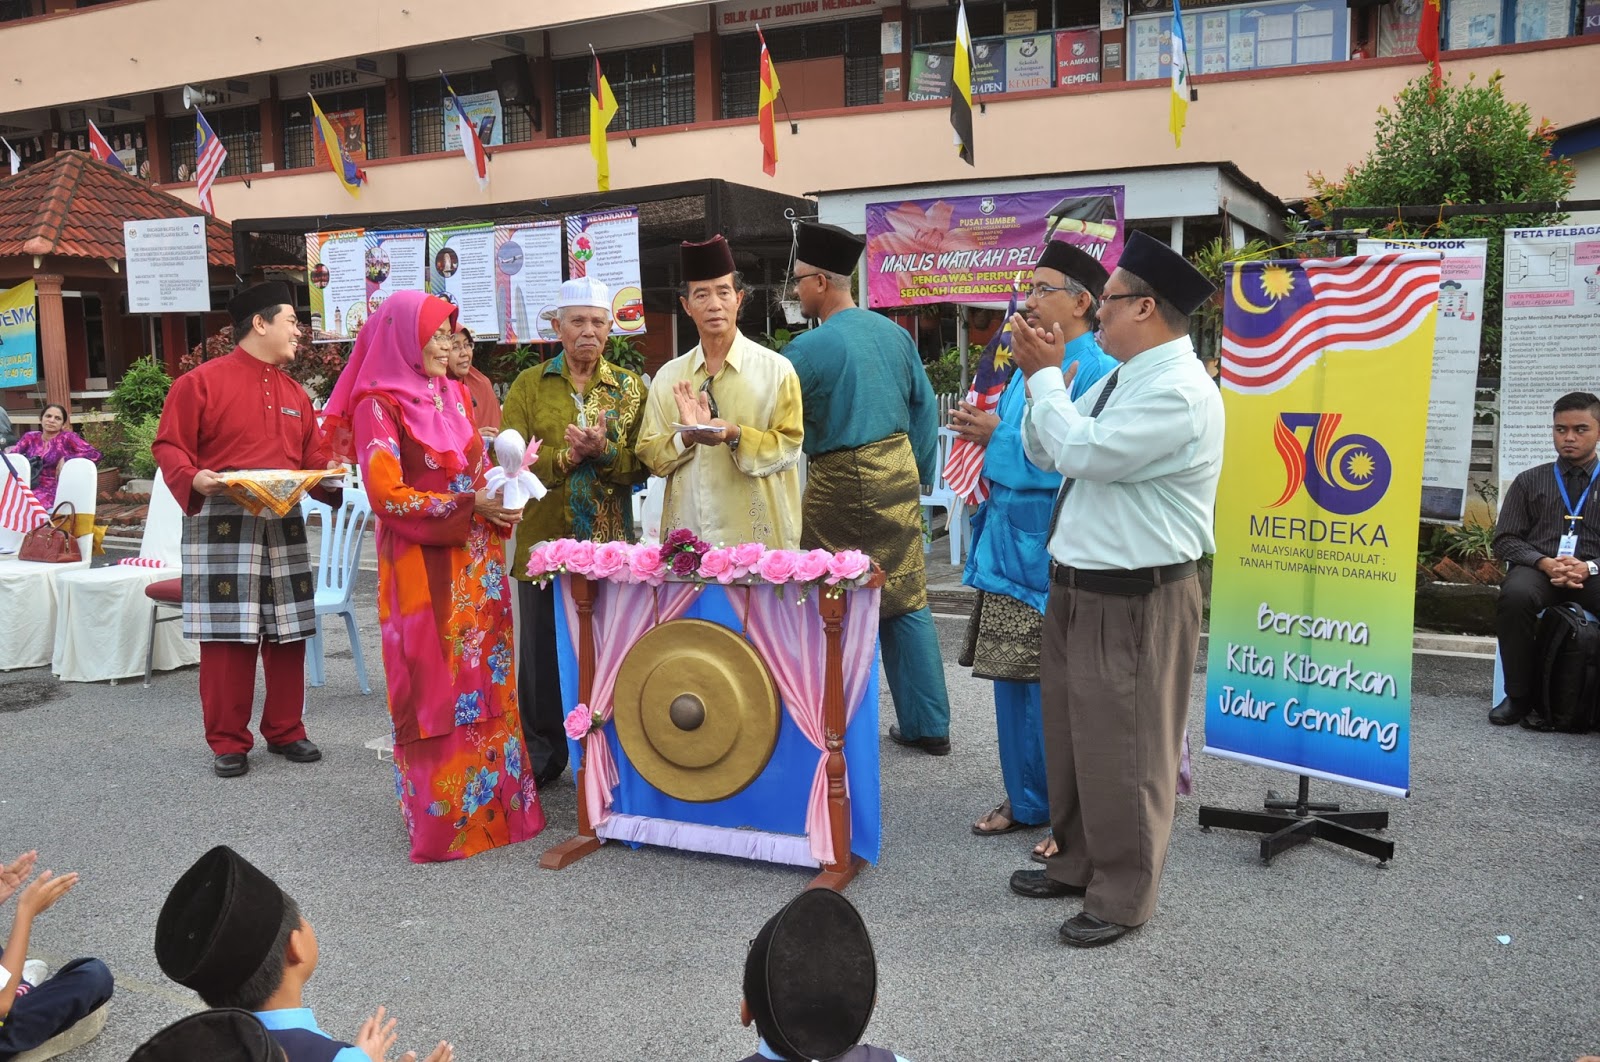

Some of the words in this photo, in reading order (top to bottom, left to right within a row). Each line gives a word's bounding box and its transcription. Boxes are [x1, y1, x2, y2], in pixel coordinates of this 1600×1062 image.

[724, 11, 747, 25] BILIK
[750, 7, 772, 21] ALAT
[776, 0, 818, 18] BANTUAN
[1070, 56, 1100, 66] AMPANG
[1008, 77, 1049, 89] KEMPEN
[1062, 72, 1099, 85] KEMPEN
[970, 82, 1003, 94] EMPEN
[586, 210, 632, 222] NEGARAKU
[960, 218, 984, 226] PUSAT
[984, 216, 1016, 225] SUMBER
[1514, 230, 1543, 238] PETA
[1385, 241, 1416, 249] PETA
[1420, 240, 1466, 249] POKOK
[880, 253, 935, 274] MAJLIS
[936, 248, 1006, 270] WATIKAH
[912, 272, 974, 285] PENGAWAS
[900, 286, 948, 298] SEKOLAH
[1249, 514, 1390, 548] MERDEKA
[1250, 543, 1314, 559] MALAYSIAKU
[1316, 548, 1380, 565] BERDAULAT
[1239, 556, 1272, 570] TANAH
[1275, 560, 1339, 577] TUMPAHNYA
[1342, 567, 1397, 583] DARAHKU
[1256, 602, 1368, 645] Bersama
[1226, 642, 1275, 678] Kita
[1282, 650, 1398, 698] Kibarkan
[1219, 684, 1276, 721] Jalur
[1283, 697, 1400, 752] Gemilang
